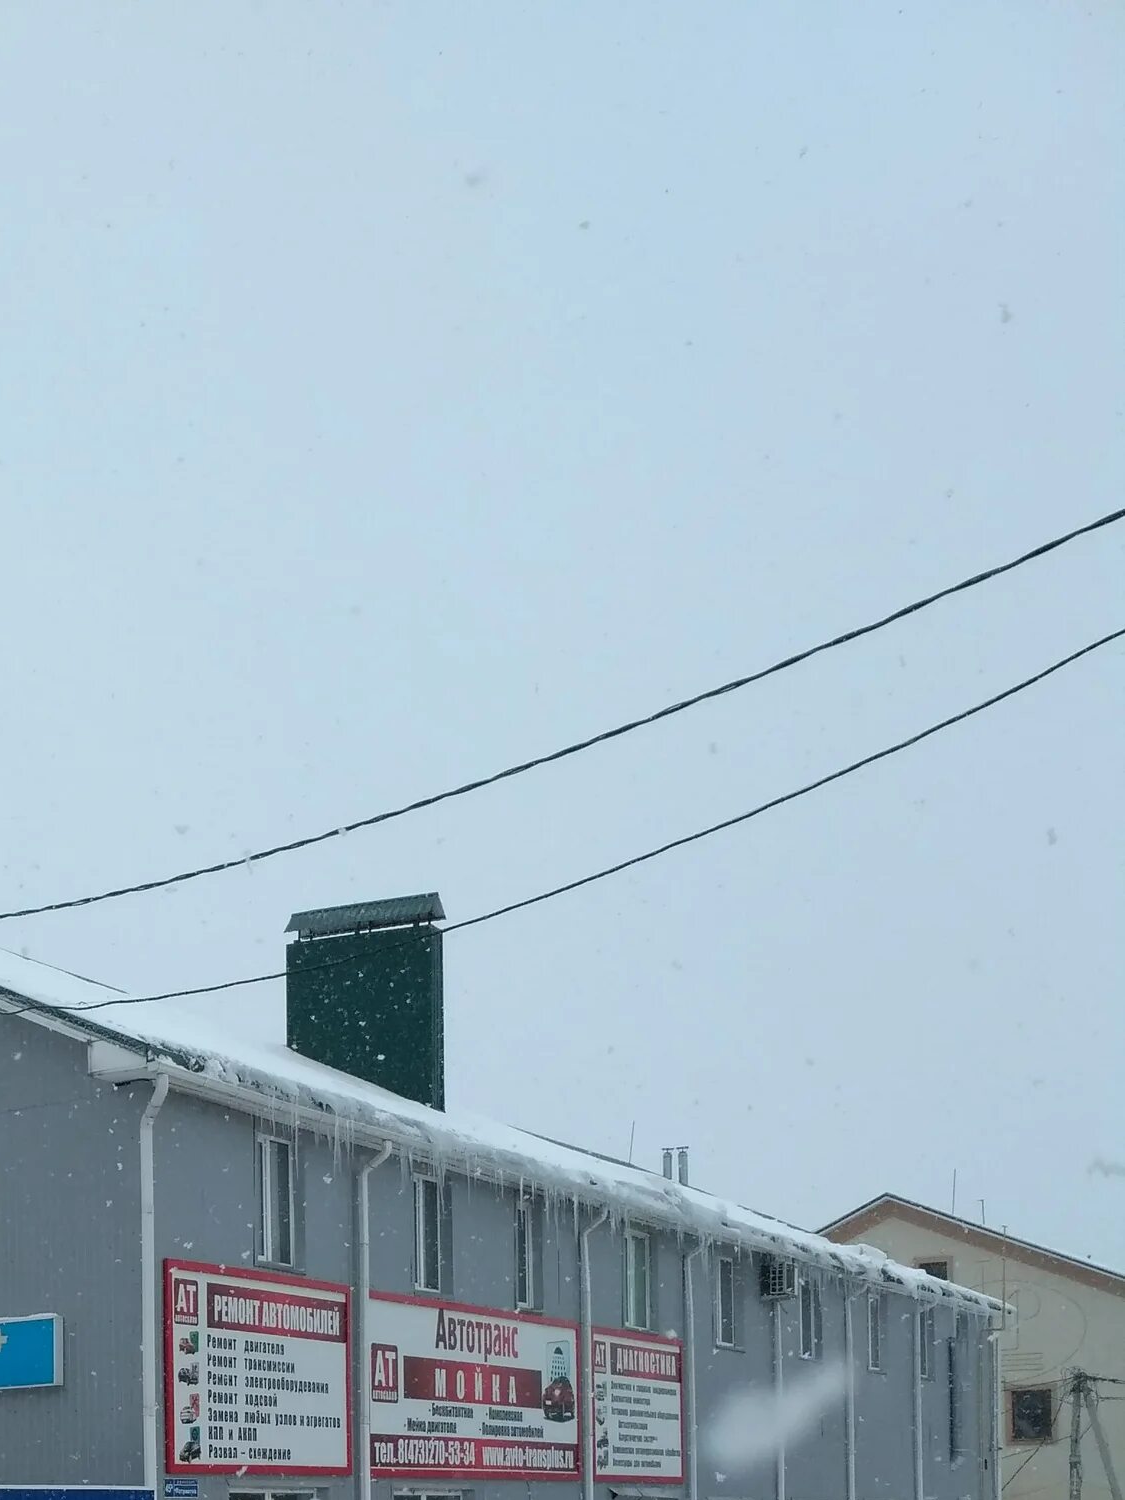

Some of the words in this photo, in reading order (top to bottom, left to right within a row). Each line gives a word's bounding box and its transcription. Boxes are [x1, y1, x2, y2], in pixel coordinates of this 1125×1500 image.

[176, 1283, 196, 1313] АТ
[214, 1294, 260, 1326] РЕМОНТ
[262, 1301, 340, 1336] АВТОМОБИЛЕЙ
[207, 1334, 237, 1351] Ремонт
[244, 1339, 285, 1355] двигателя
[435, 1309, 518, 1362] Автотранс
[207, 1353, 237, 1369] Ремонт
[244, 1357, 296, 1374] трансмиссии
[595, 1343, 605, 1366] АТ
[616, 1347, 677, 1377] ДИАГНОСТИКА
[208, 1371, 238, 1387] Ремонт
[375, 1351, 396, 1387] АТ
[435, 1366, 517, 1404] МОЙКА
[208, 1389, 238, 1405] Ремонт
[244, 1393, 278, 1408] ходовой
[208, 1407, 239, 1423] Замена
[244, 1409, 271, 1425] любых
[275, 1413, 297, 1427] узлов
[306, 1416, 341, 1429] агрегатов
[208, 1426, 224, 1441] КПП
[228, 1428, 234, 1440] и
[238, 1427, 258, 1442] АКПП
[208, 1444, 238, 1459] Развал
[248, 1447, 292, 1461] схождение
[482, 1445, 574, 1471] www.avto-transplus.ru
